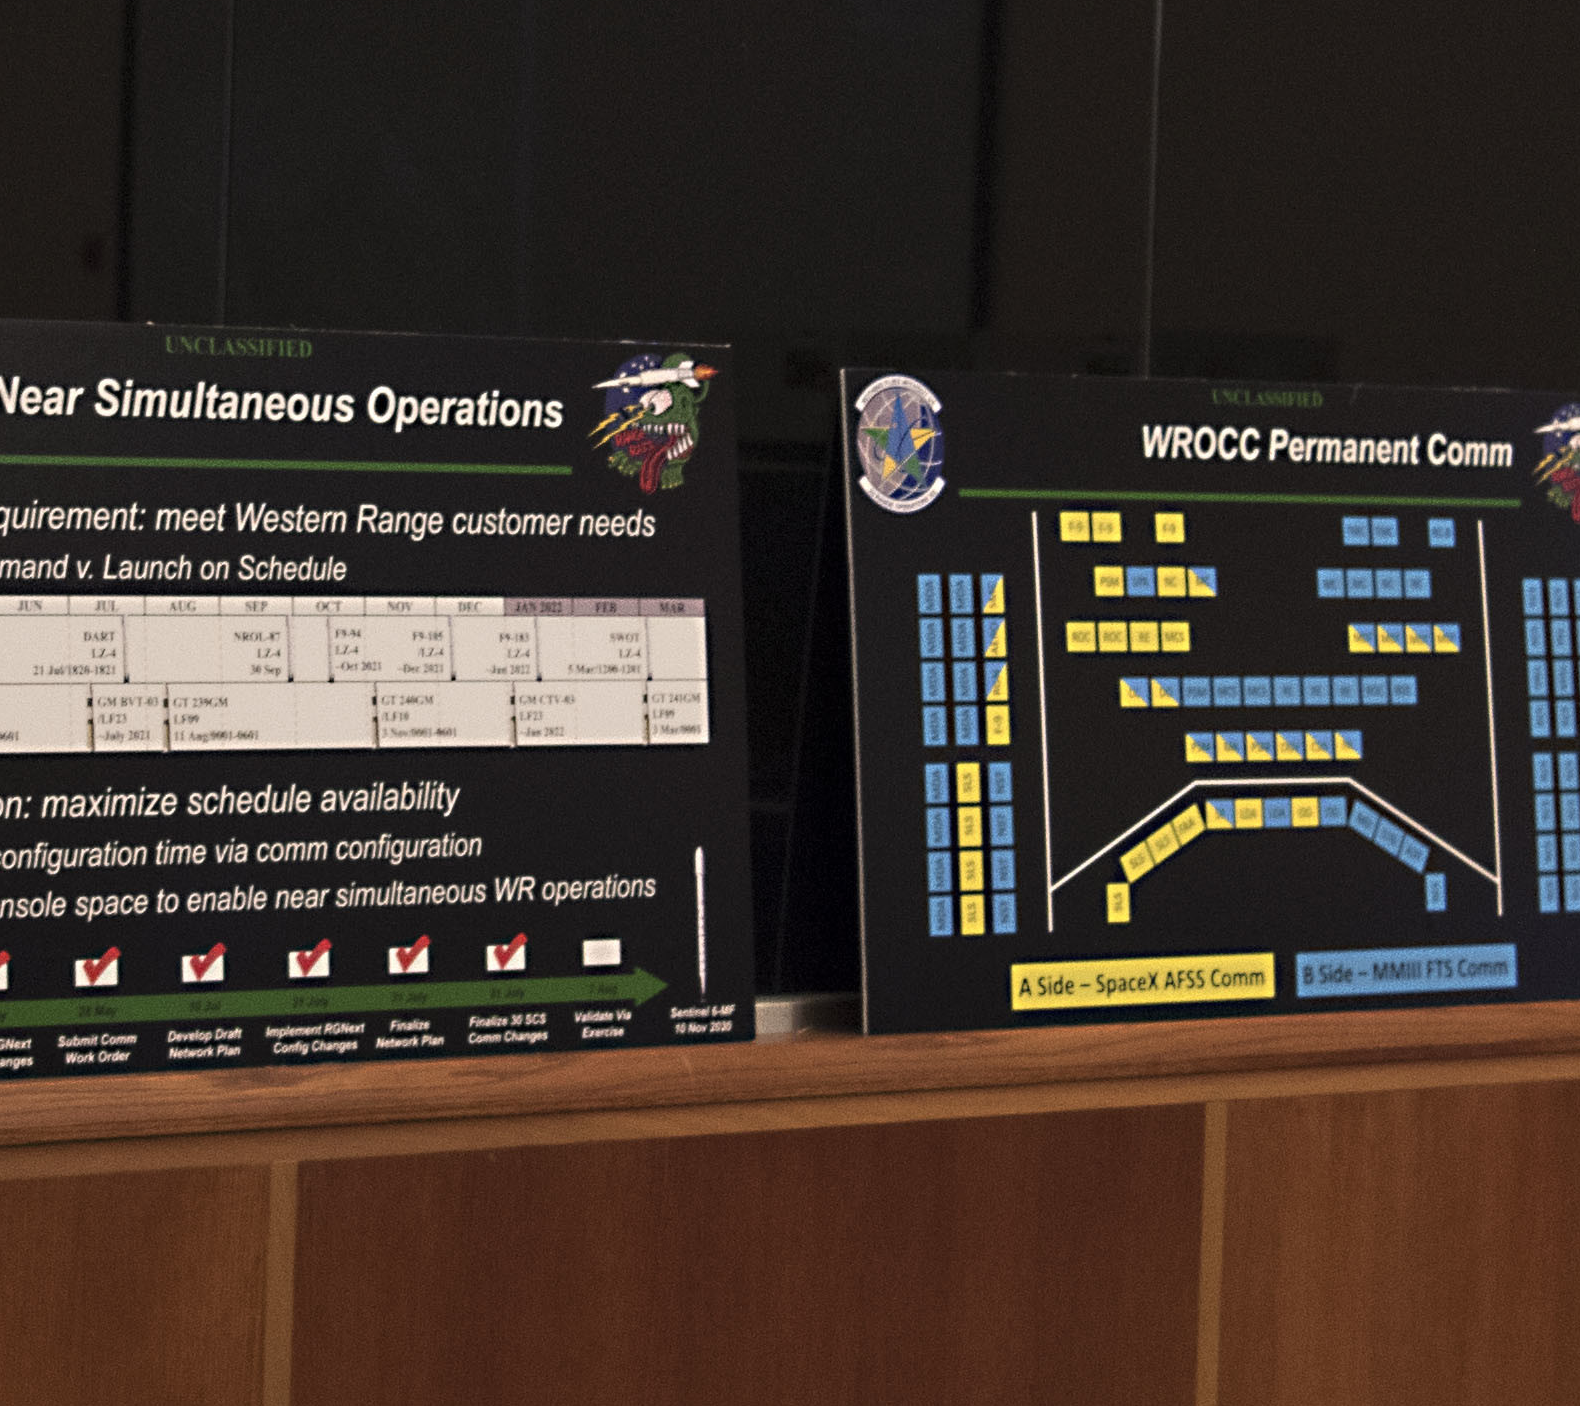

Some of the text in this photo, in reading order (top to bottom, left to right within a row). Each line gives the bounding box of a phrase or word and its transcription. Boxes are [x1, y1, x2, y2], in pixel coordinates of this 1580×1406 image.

[165, 334, 312, 359] UNCLASSIFIED
[94, 378, 354, 422] Simultaneous
[368, 386, 563, 433] Operations
[1143, 425, 1513, 466] WROCC Permanent Comm
[155, 504, 226, 531] meet
[236, 503, 347, 532] Western
[357, 504, 443, 541] Range
[452, 508, 573, 535] customer
[579, 509, 655, 537] needs
[77, 561, 92, 579] v.
[103, 554, 192, 580] Launch
[200, 561, 229, 580] on
[238, 555, 347, 581] Schedule
[17, 600, 43, 612] JUN
[95, 600, 119, 612] JUL
[170, 600, 197, 612] AUG
[245, 600, 268, 612] SEP
[316, 601, 342, 612] OCT
[388, 601, 412, 612] NOV
[458, 601, 483, 612] DEC
[83, 631, 115, 642] DART
[42, 787, 177, 818] maximize
[187, 784, 311, 815] schedule
[320, 781, 460, 817] availability
[156, 840, 206, 865] time
[216, 838, 248, 863] via
[256, 841, 328, 862] comm
[336, 833, 482, 865] configuration
[75, 894, 148, 921] space
[157, 889, 179, 913] to
[187, 885, 267, 912] enable
[275, 889, 330, 909] near
[335, 881, 486, 907] simultaneous
[495, 876, 535, 901] WR
[542, 874, 656, 906] operations
[1302, 966, 1315, 986] B
[1319, 964, 1353, 985] Side
[1426, 959, 1454, 979] FTS
[1458, 958, 1509, 978] Comm
[1019, 968, 1265, 996] A Side SpaceX AFSS Comm
[265, 1025, 322, 1038] Implement
[390, 1019, 431, 1032] Finalize
[57, 1034, 138, 1048] Submit Comm
[168, 1027, 243, 1043] Develop Draft
[421, 1034, 445, 1046] Plan
[169, 1045, 241, 1059] Network Plan
[273, 1040, 358, 1055] Config Changes
[65, 1051, 131, 1065] Work Order
